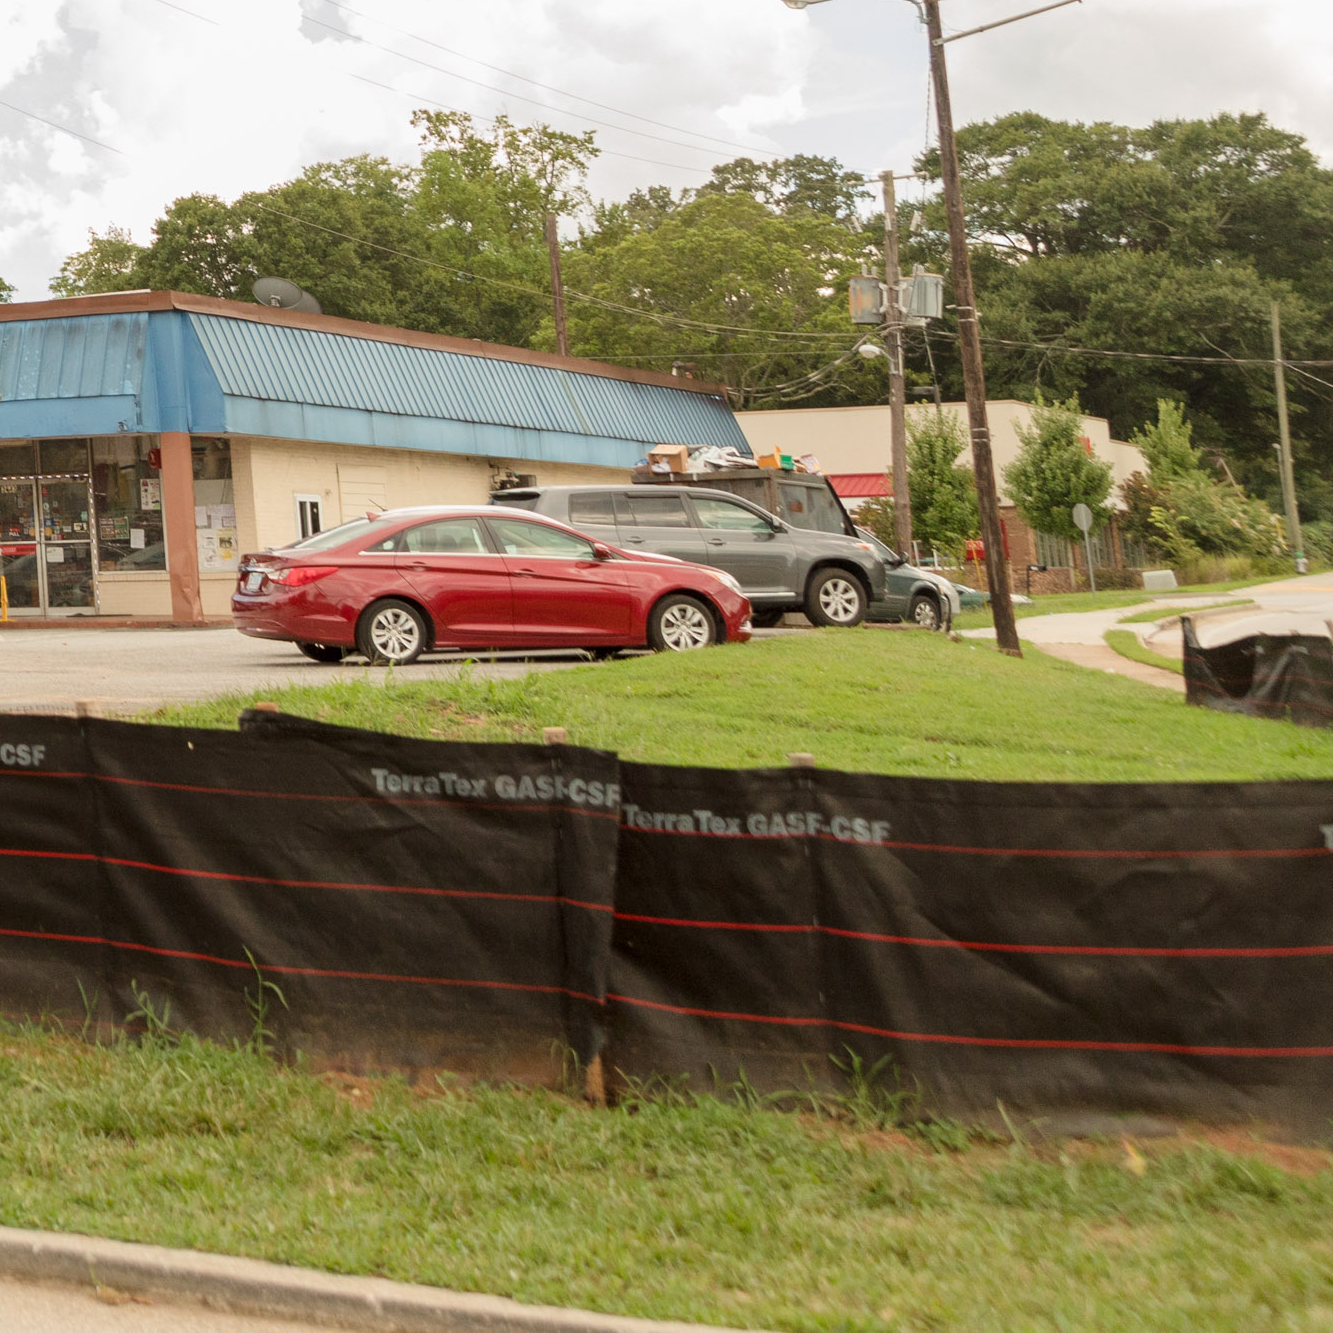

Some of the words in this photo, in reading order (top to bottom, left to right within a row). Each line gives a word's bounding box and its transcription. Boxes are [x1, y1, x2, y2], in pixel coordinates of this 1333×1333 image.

[371, 768, 488, 799] TerraTex
[495, 775, 620, 809] GASF-CSF
[621, 802, 742, 836] TerraTex
[746, 811, 892, 844] GASF-CSF
